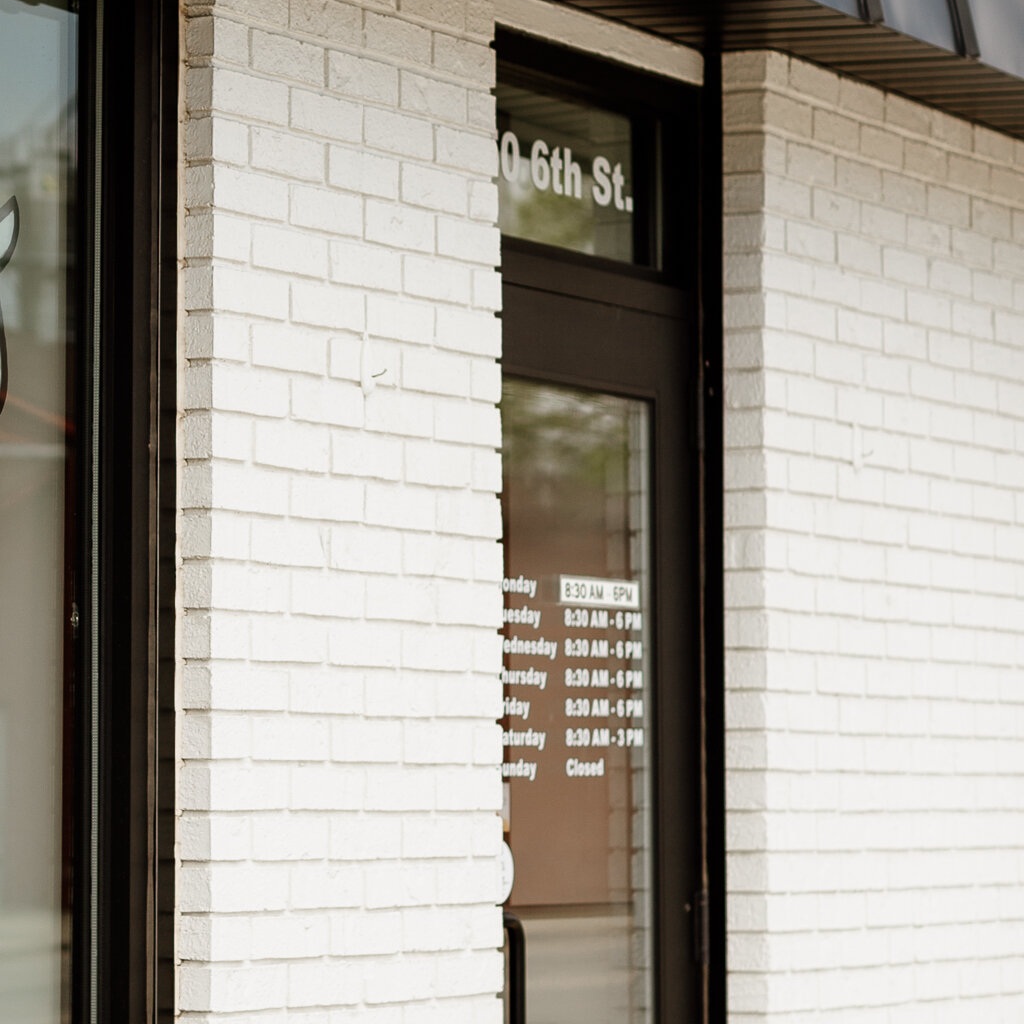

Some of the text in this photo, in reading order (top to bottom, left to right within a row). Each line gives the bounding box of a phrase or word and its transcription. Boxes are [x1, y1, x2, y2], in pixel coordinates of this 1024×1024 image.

[531, 139, 582, 200] 6th
[592, 156, 633, 212] St.
[502, 575, 537, 598] onday
[565, 583, 587, 599] 8:30
[589, 584, 604, 599] AM
[503, 605, 541, 629] uesday
[564, 608, 589, 628] 8:30
[590, 609, 609, 629] AM
[616, 611, 624, 630] 6
[625, 611, 643, 631] PM
[503, 635, 557, 660] ednesday
[564, 638, 589, 658] 8:30
[590, 639, 609, 658] AM
[616, 641, 624, 659] 6
[625, 641, 643, 660] PM
[501, 666, 547, 690] hursday
[565, 668, 590, 688] 8:30
[591, 669, 610, 688] AM
[616, 670, 624, 689] 6
[626, 670, 643, 689] PM
[565, 698, 590, 717] 8:30
[591, 698, 610, 717] AM
[616, 698, 625, 718] 6
[626, 699, 643, 718] PM
[503, 728, 546, 751] aturday
[565, 728, 591, 747] 8:30
[591, 728, 611, 747] AM
[617, 728, 625, 747] 3
[626, 728, 644, 747] PM
[565, 758, 605, 777] Closed
